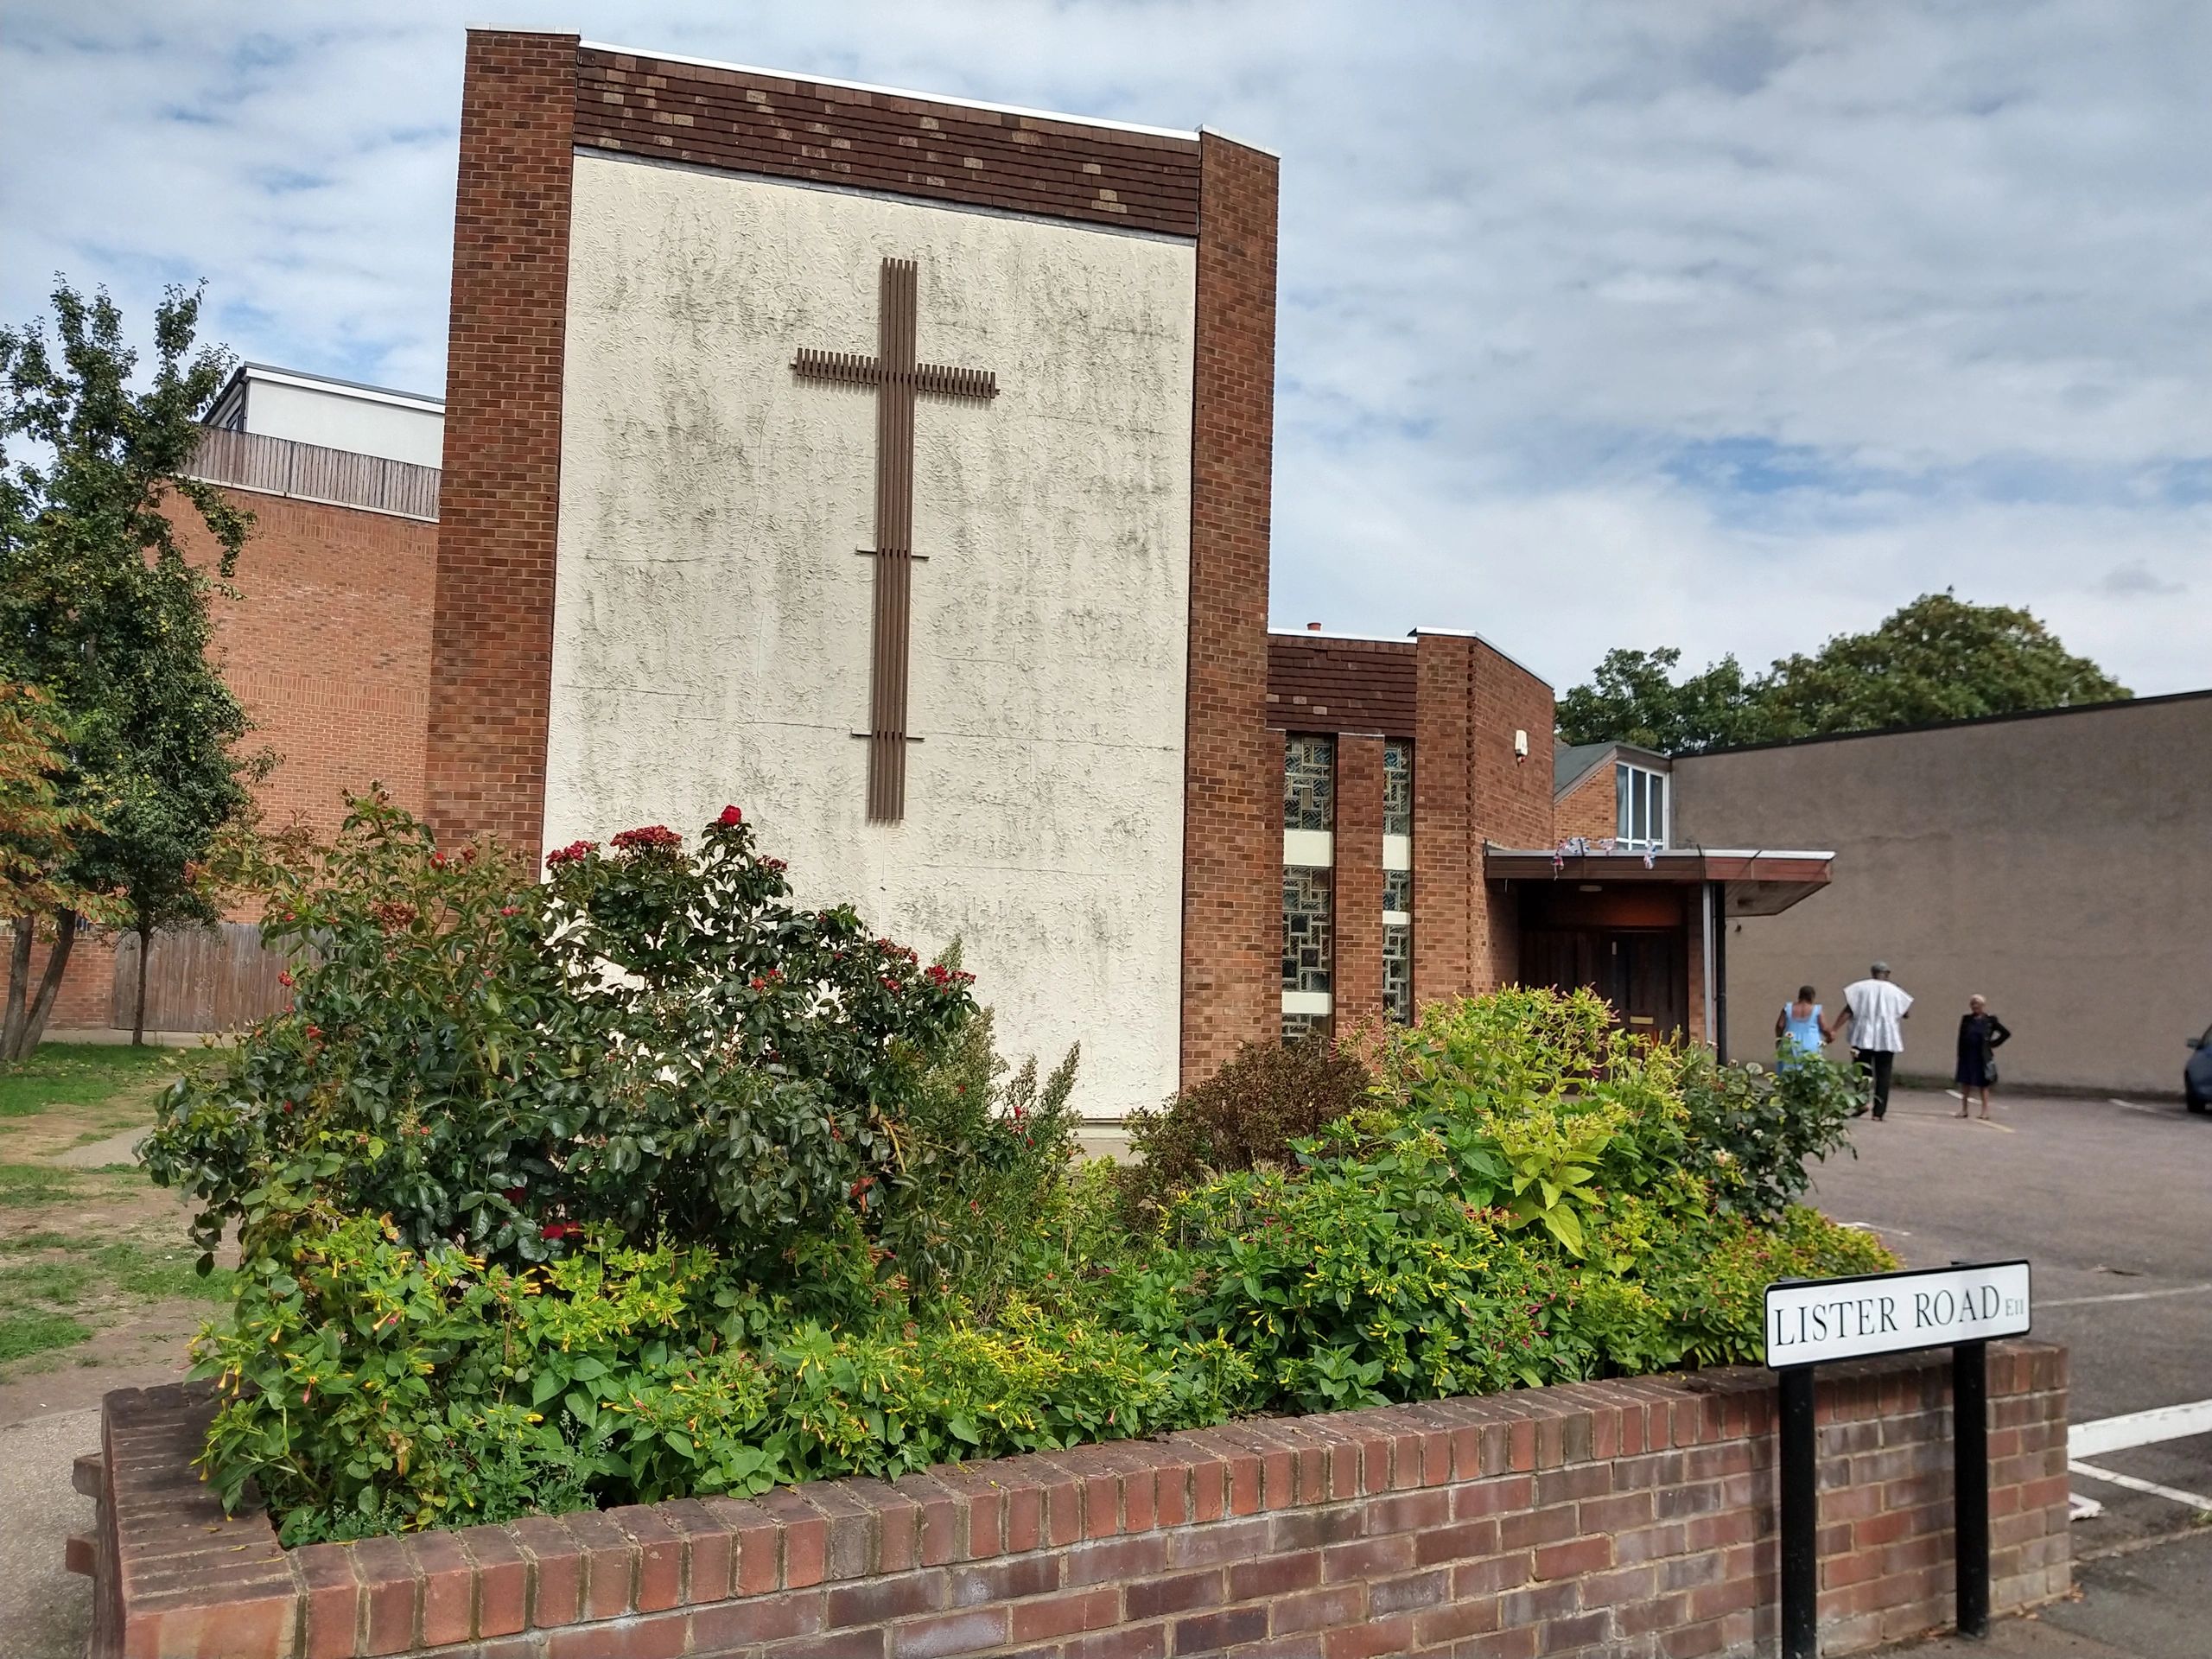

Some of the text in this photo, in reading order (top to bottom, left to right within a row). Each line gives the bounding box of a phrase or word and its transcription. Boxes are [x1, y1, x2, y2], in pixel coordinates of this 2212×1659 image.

[1775, 1286, 2024, 1346] LISTER ROAD E11
